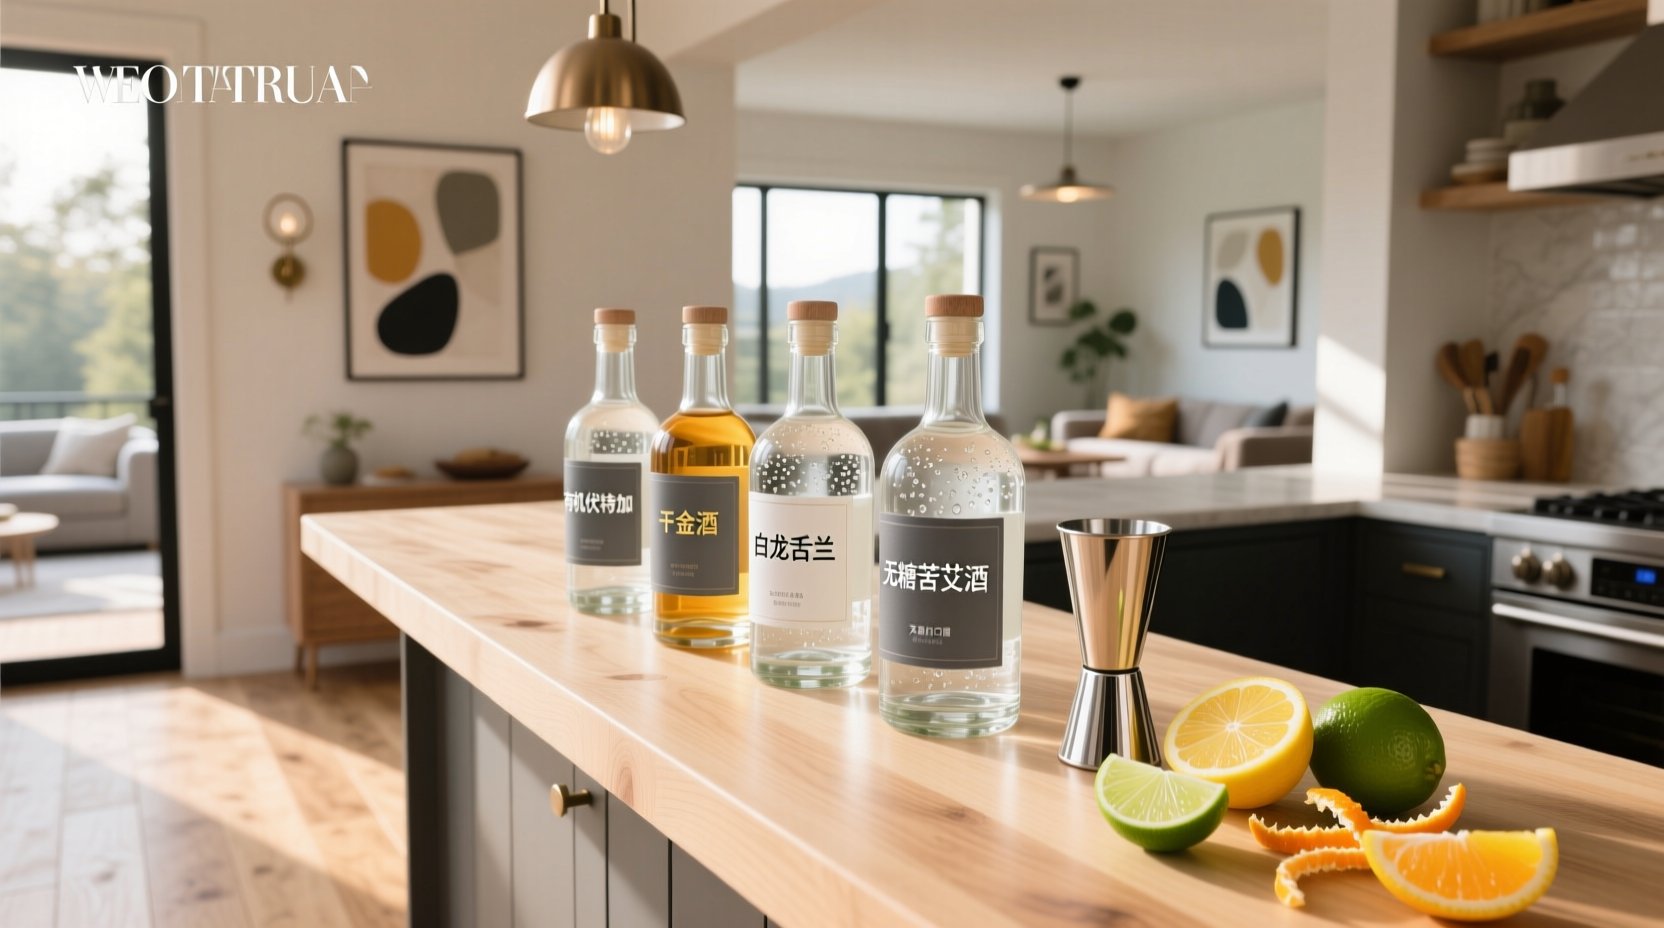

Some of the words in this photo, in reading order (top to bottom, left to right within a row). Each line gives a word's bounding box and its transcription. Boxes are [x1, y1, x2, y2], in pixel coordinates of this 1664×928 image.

[659, 510, 719, 536] 干金酒
[755, 532, 836, 562] 白龙舌兰
[883, 559, 989, 593] 无糖苦艾酒
